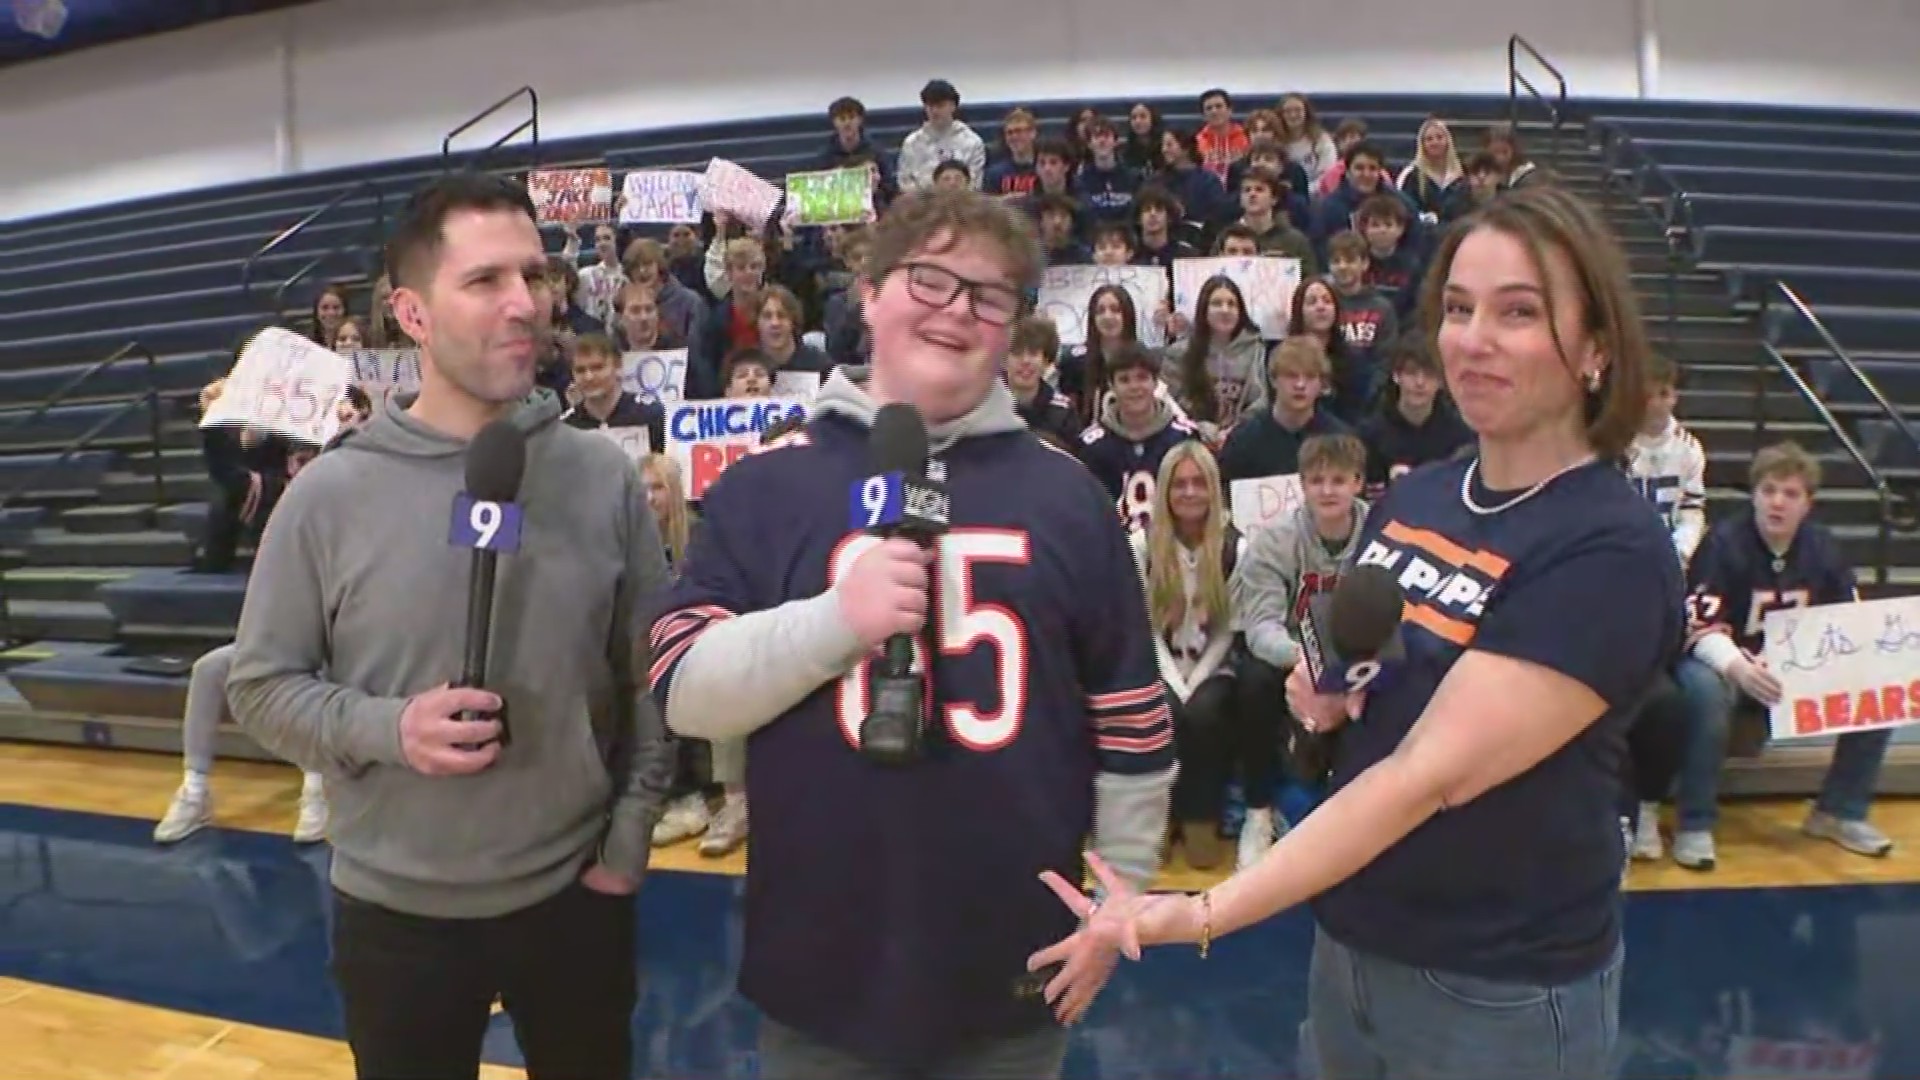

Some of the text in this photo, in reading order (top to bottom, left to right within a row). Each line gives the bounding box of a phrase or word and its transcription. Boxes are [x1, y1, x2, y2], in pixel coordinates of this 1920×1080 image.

[671, 402, 808, 441] CHICAGO
[470, 500, 502, 548] 9
[861, 475, 889, 527] 9
[1344, 661, 1382, 692] 9
[1793, 678, 1920, 735] BEARS
